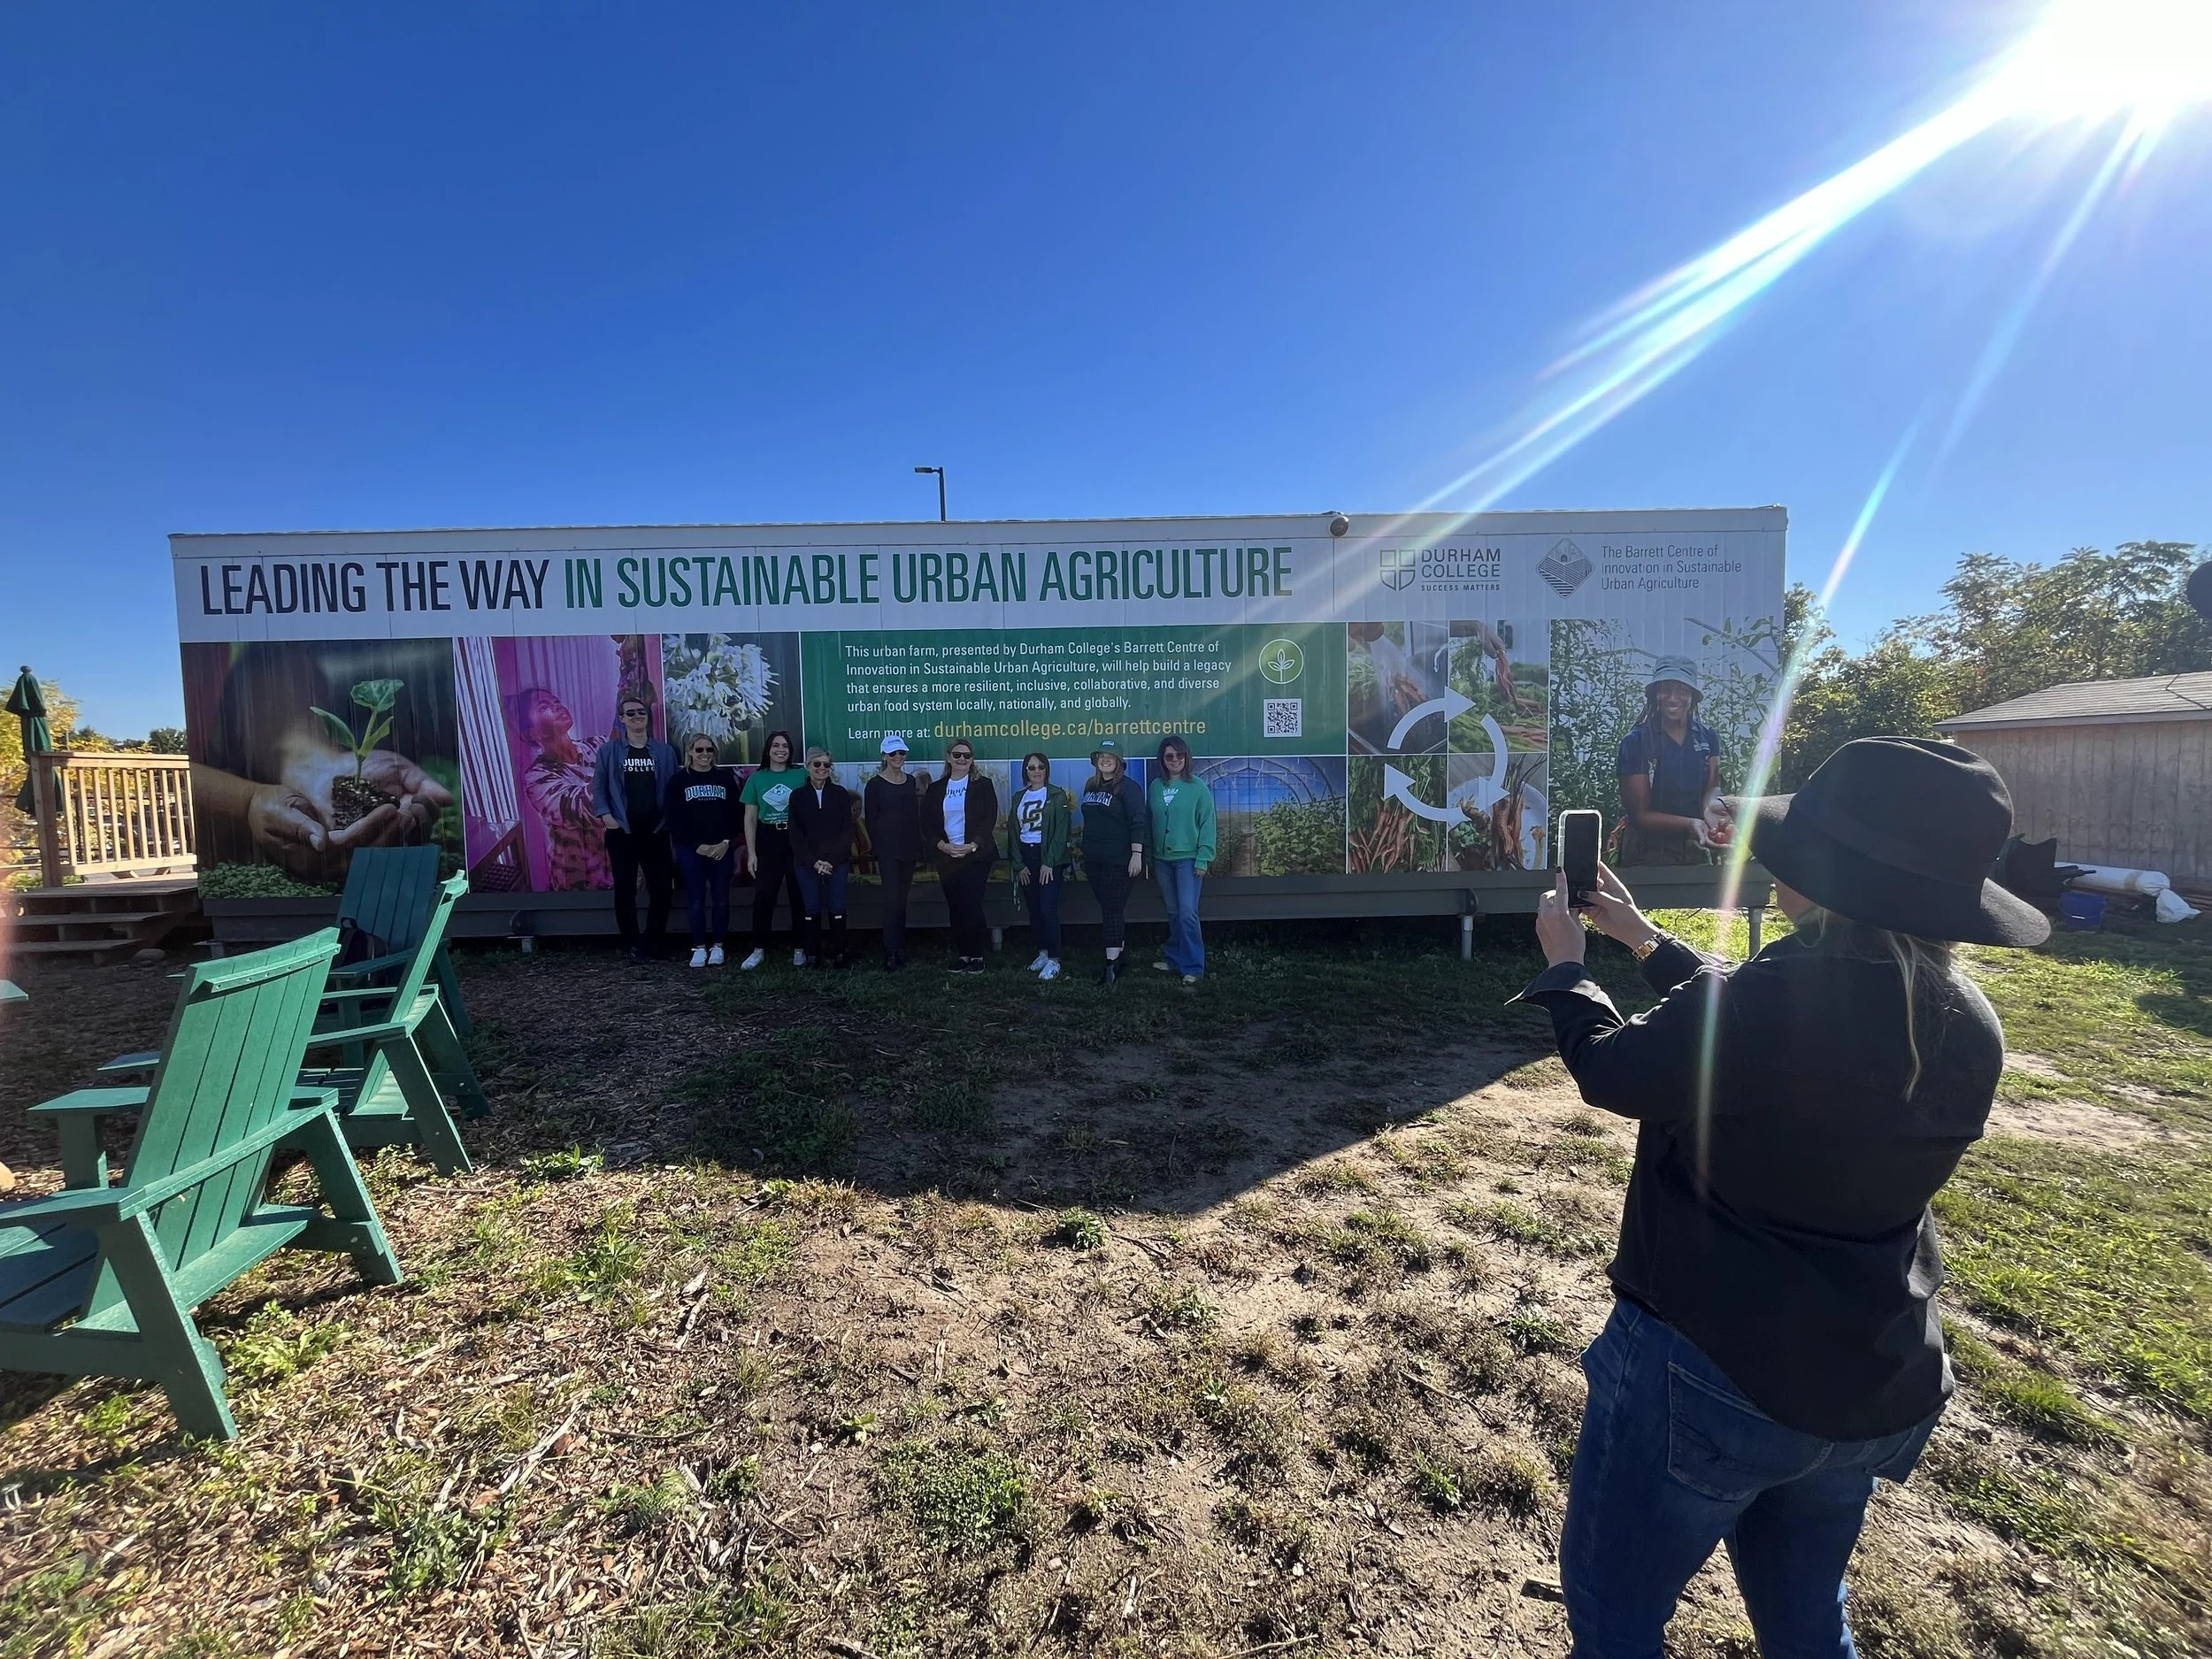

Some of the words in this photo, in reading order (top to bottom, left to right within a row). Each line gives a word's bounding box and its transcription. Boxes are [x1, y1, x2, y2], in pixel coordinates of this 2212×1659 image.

[1421, 548, 1501, 563] DURHAM
[1601, 545, 1622, 558] The
[1625, 545, 1664, 558] Barrett
[1667, 544, 1704, 557] Centre
[1707, 544, 1718, 557] of
[1421, 564, 1501, 578] COLLEGE
[1601, 562, 1659, 574] Innovation
[1663, 563, 1673, 573] in
[1677, 560, 1742, 573] Sustainable
[200, 562, 366, 615] LEADING
[375, 560, 451, 612] THE
[458, 558, 550, 610] WAY
[565, 558, 603, 609] IN
[617, 553, 879, 609] SUSTAINABLE
[892, 551, 1026, 603] URBAN
[1039, 546, 1293, 602] AGRICULTURE
[1601, 577, 1634, 590] Urban
[1638, 576, 1700, 592] Agriculture
[845, 645, 870, 657] This
[872, 645, 906, 657] urban
[909, 645, 939, 657] farm,
[941, 643, 1000, 658] presented
[1003, 643, 1017, 657] by
[1019, 642, 1064, 656] Durham
[1068, 641, 1121, 657] College's
[1124, 641, 1164, 653] Barrett
[1167, 641, 1205, 653] Centre
[1208, 641, 1219, 653] of
[846, 664, 906, 675] Innovation
[910, 664, 920, 675] in
[924, 662, 990, 674] Sustainable
[994, 661, 1029, 673] Urban
[1032, 661, 1099, 675] Agriculture,
[1102, 660, 1122, 672] will
[1125, 660, 1149, 673] help
[1153, 659, 1180, 672] build
[1183, 662, 1190, 672] a
[1194, 659, 1232, 673] legacy
[846, 682, 870, 694] that
[872, 683, 918, 694] ensures
[921, 685, 928, 694] a
[932, 683, 961, 693] more
[964, 680, 1014, 693] resilient,
[1017, 679, 1071, 692] inclusive,
[1073, 678, 1151, 691] collaborative,
[1154, 678, 1175, 689] and
[1178, 677, 1220, 689] diverse
[848, 700, 880, 712] urban
[884, 699, 910, 711] food
[912, 701, 953, 713] system
[956, 698, 996, 712] locally,
[999, 697, 1057, 711] nationally,
[1060, 697, 1081, 709] and
[1084, 696, 1132, 710] globally.
[848, 727, 880, 740] Learn
[884, 728, 913, 738] more
[917, 727, 931, 739] at:
[933, 718, 1207, 740] durhamcollege.ca/barrettcentre
[685, 785, 726, 802] DURHAM
